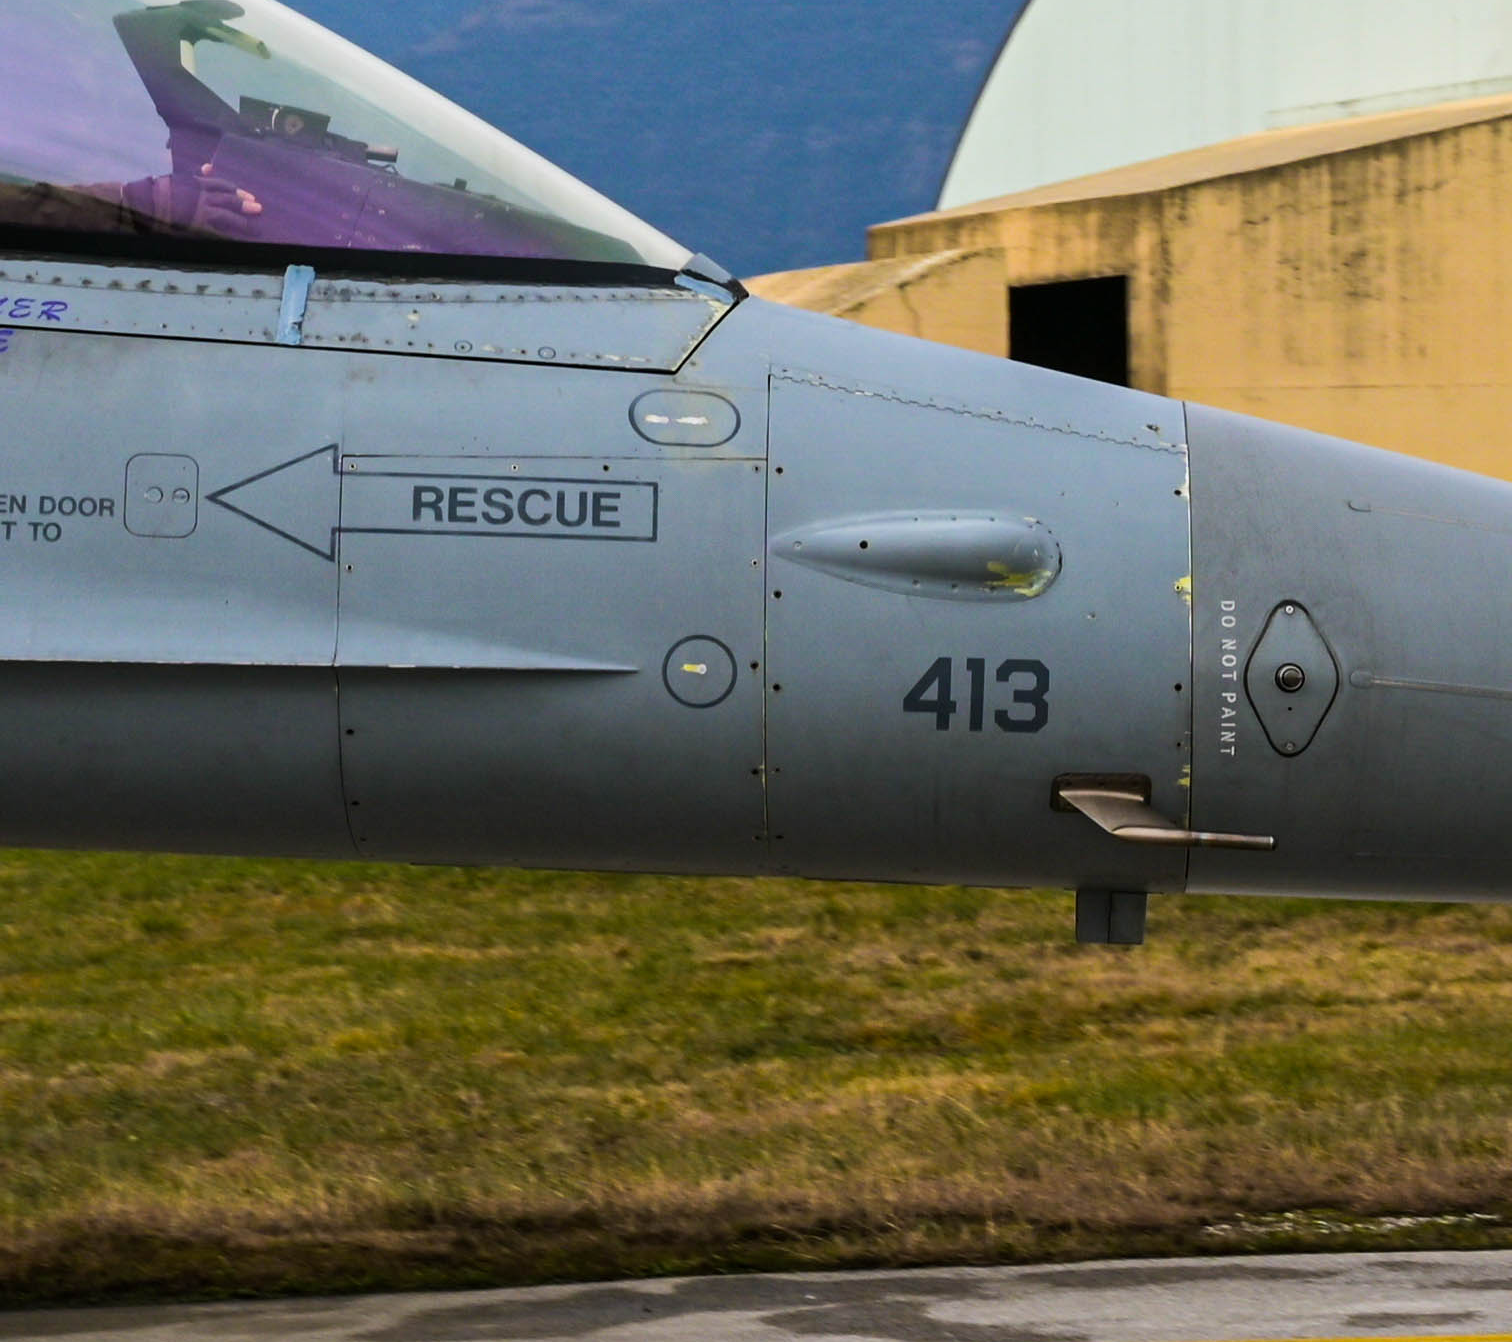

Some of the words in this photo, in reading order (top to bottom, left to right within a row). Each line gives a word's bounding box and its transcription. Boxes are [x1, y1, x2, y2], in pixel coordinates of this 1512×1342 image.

[38, 495, 115, 517] DOOR
[411, 484, 622, 528] RESCUE
[28, 522, 62, 542] TO
[1220, 600, 1237, 628] DO
[1221, 639, 1237, 681] NOT
[902, 656, 1050, 734] 413
[1220, 692, 1237, 757] PAINT
